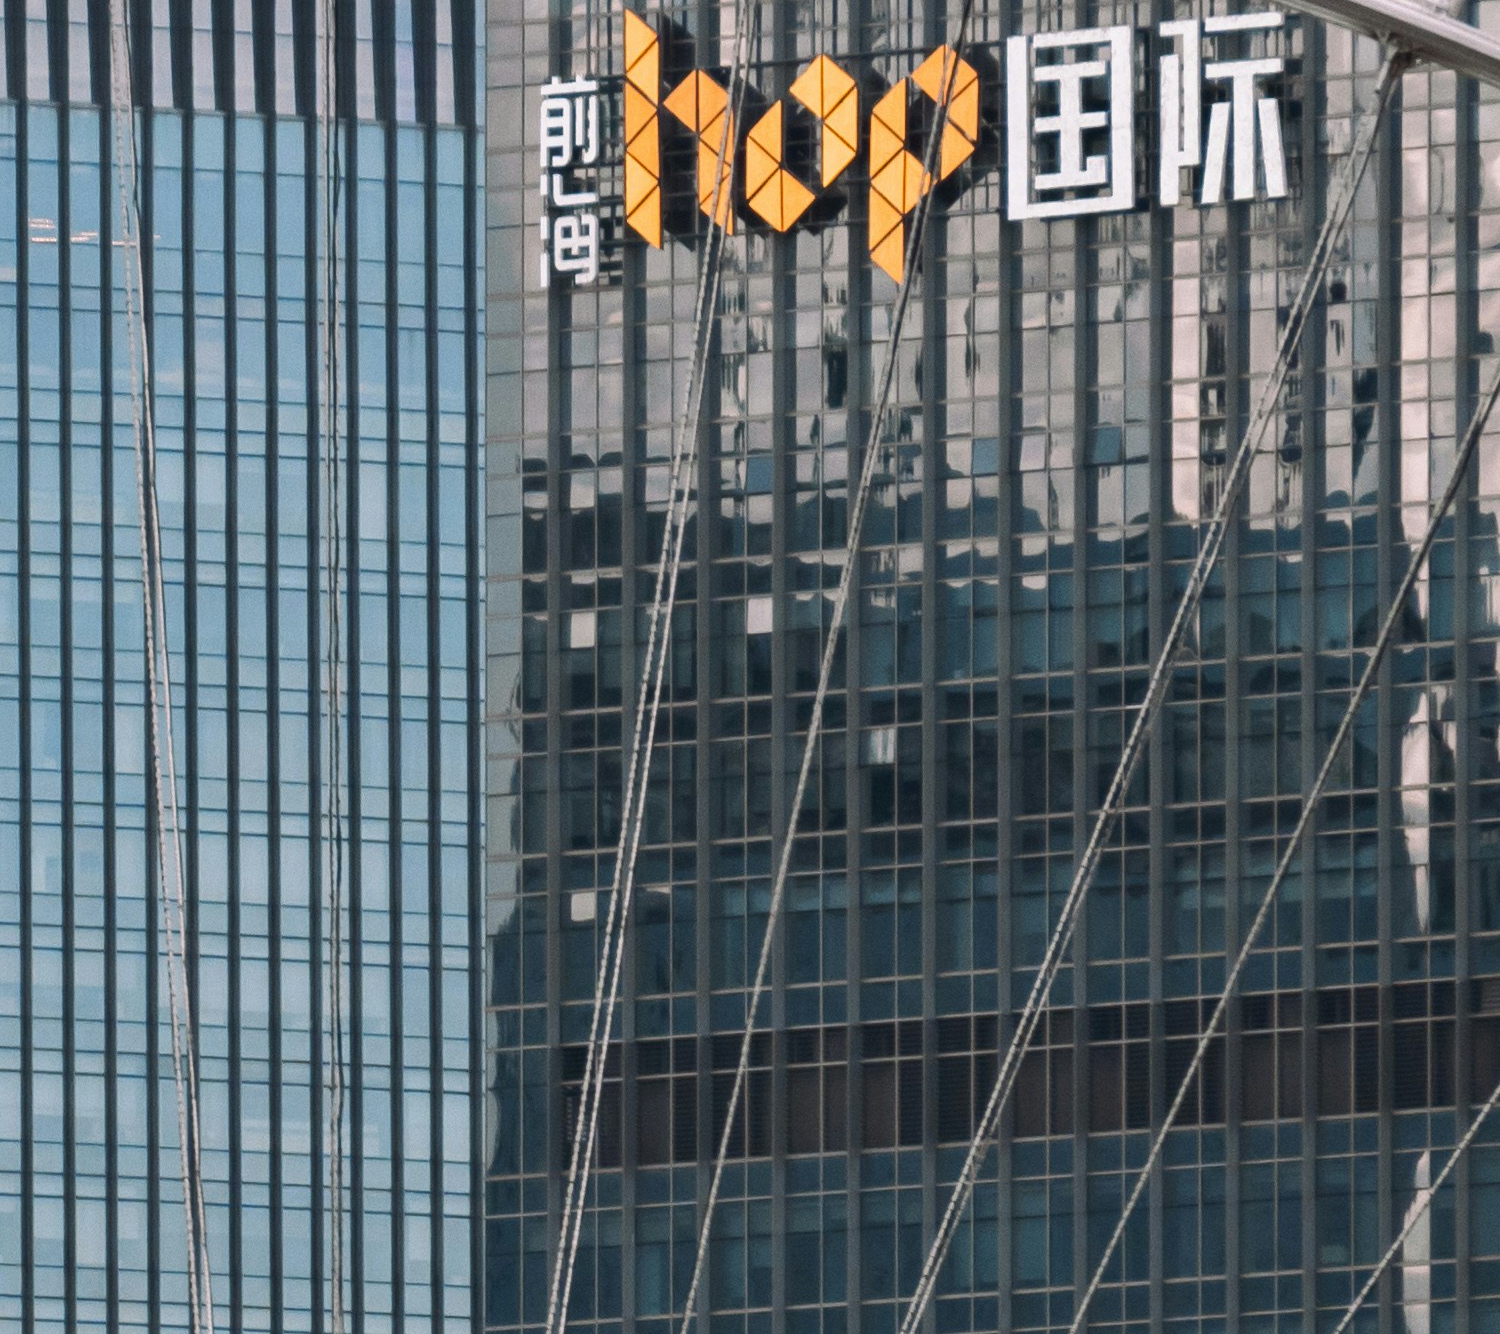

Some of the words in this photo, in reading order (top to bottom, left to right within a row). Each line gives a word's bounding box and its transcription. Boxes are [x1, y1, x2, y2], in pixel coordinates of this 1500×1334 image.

[540, 75, 598, 287] 前海
[624, 8, 981, 285] hop
[1006, 12, 1288, 222] 国际
